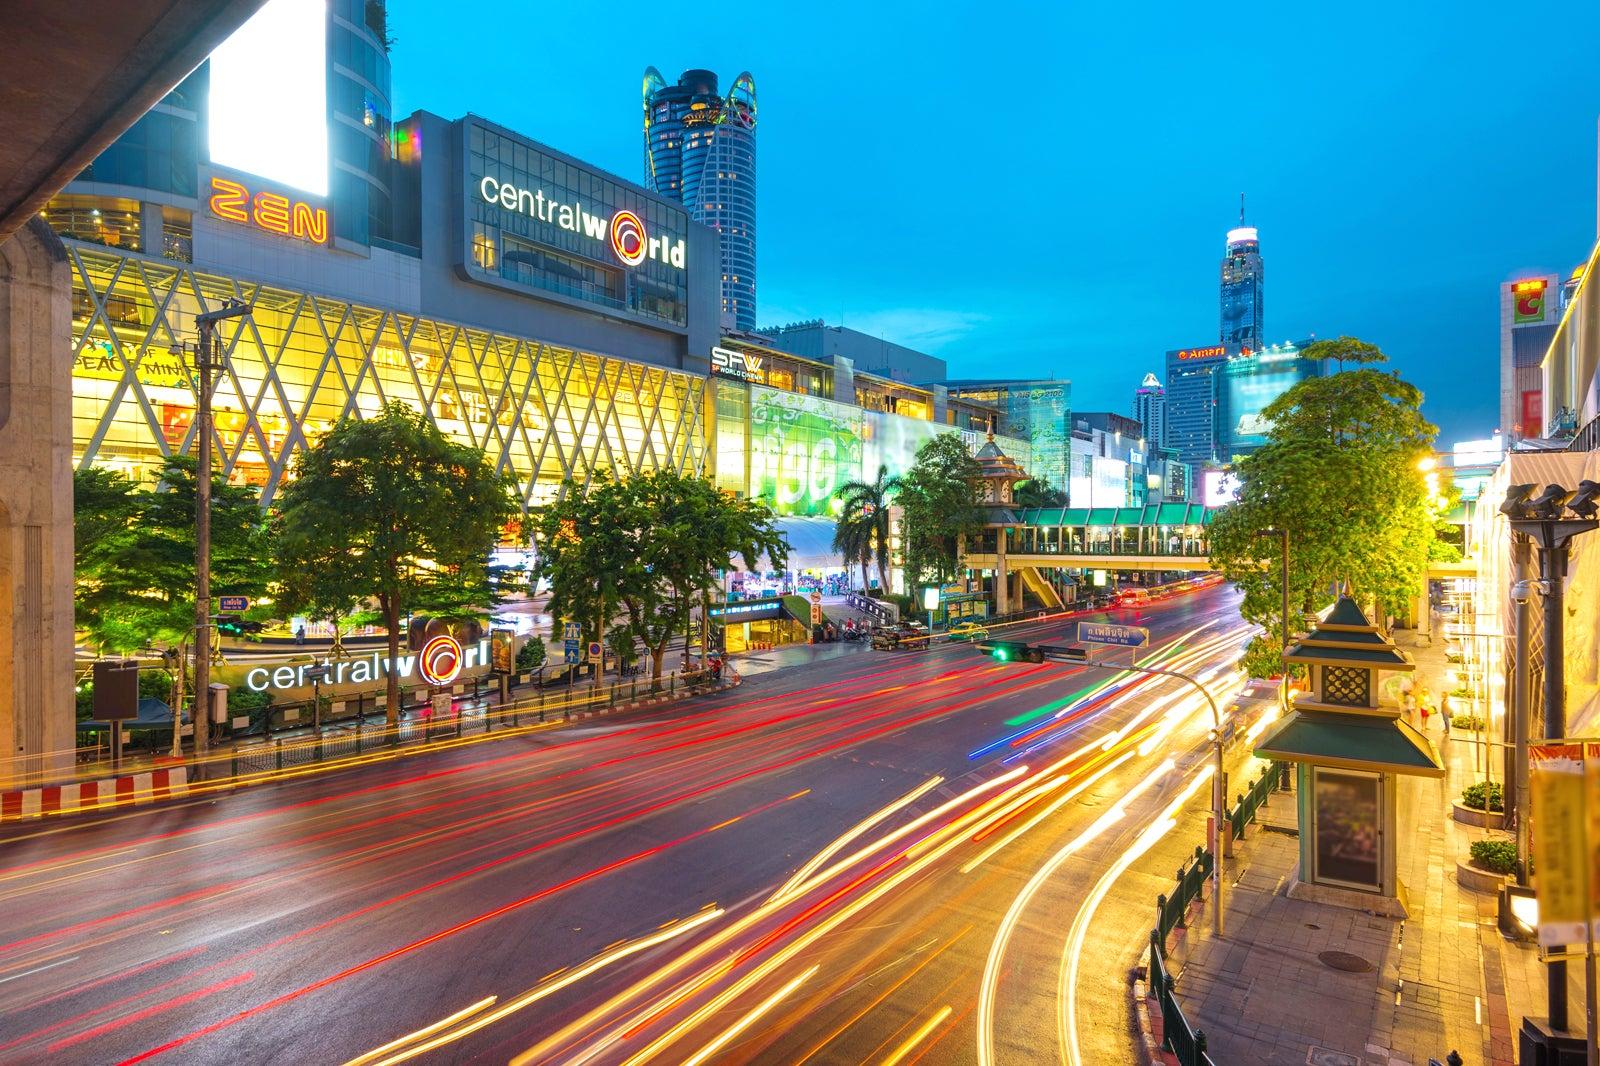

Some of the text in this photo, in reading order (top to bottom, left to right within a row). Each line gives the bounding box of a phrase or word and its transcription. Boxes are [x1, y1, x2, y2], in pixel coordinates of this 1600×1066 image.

[210, 177, 327, 243] ZEN
[480, 176, 686, 269] centralworld
[711, 346, 763, 372] SFW
[1189, 347, 1226, 360] Amari
[720, 367, 740, 375] WORLD
